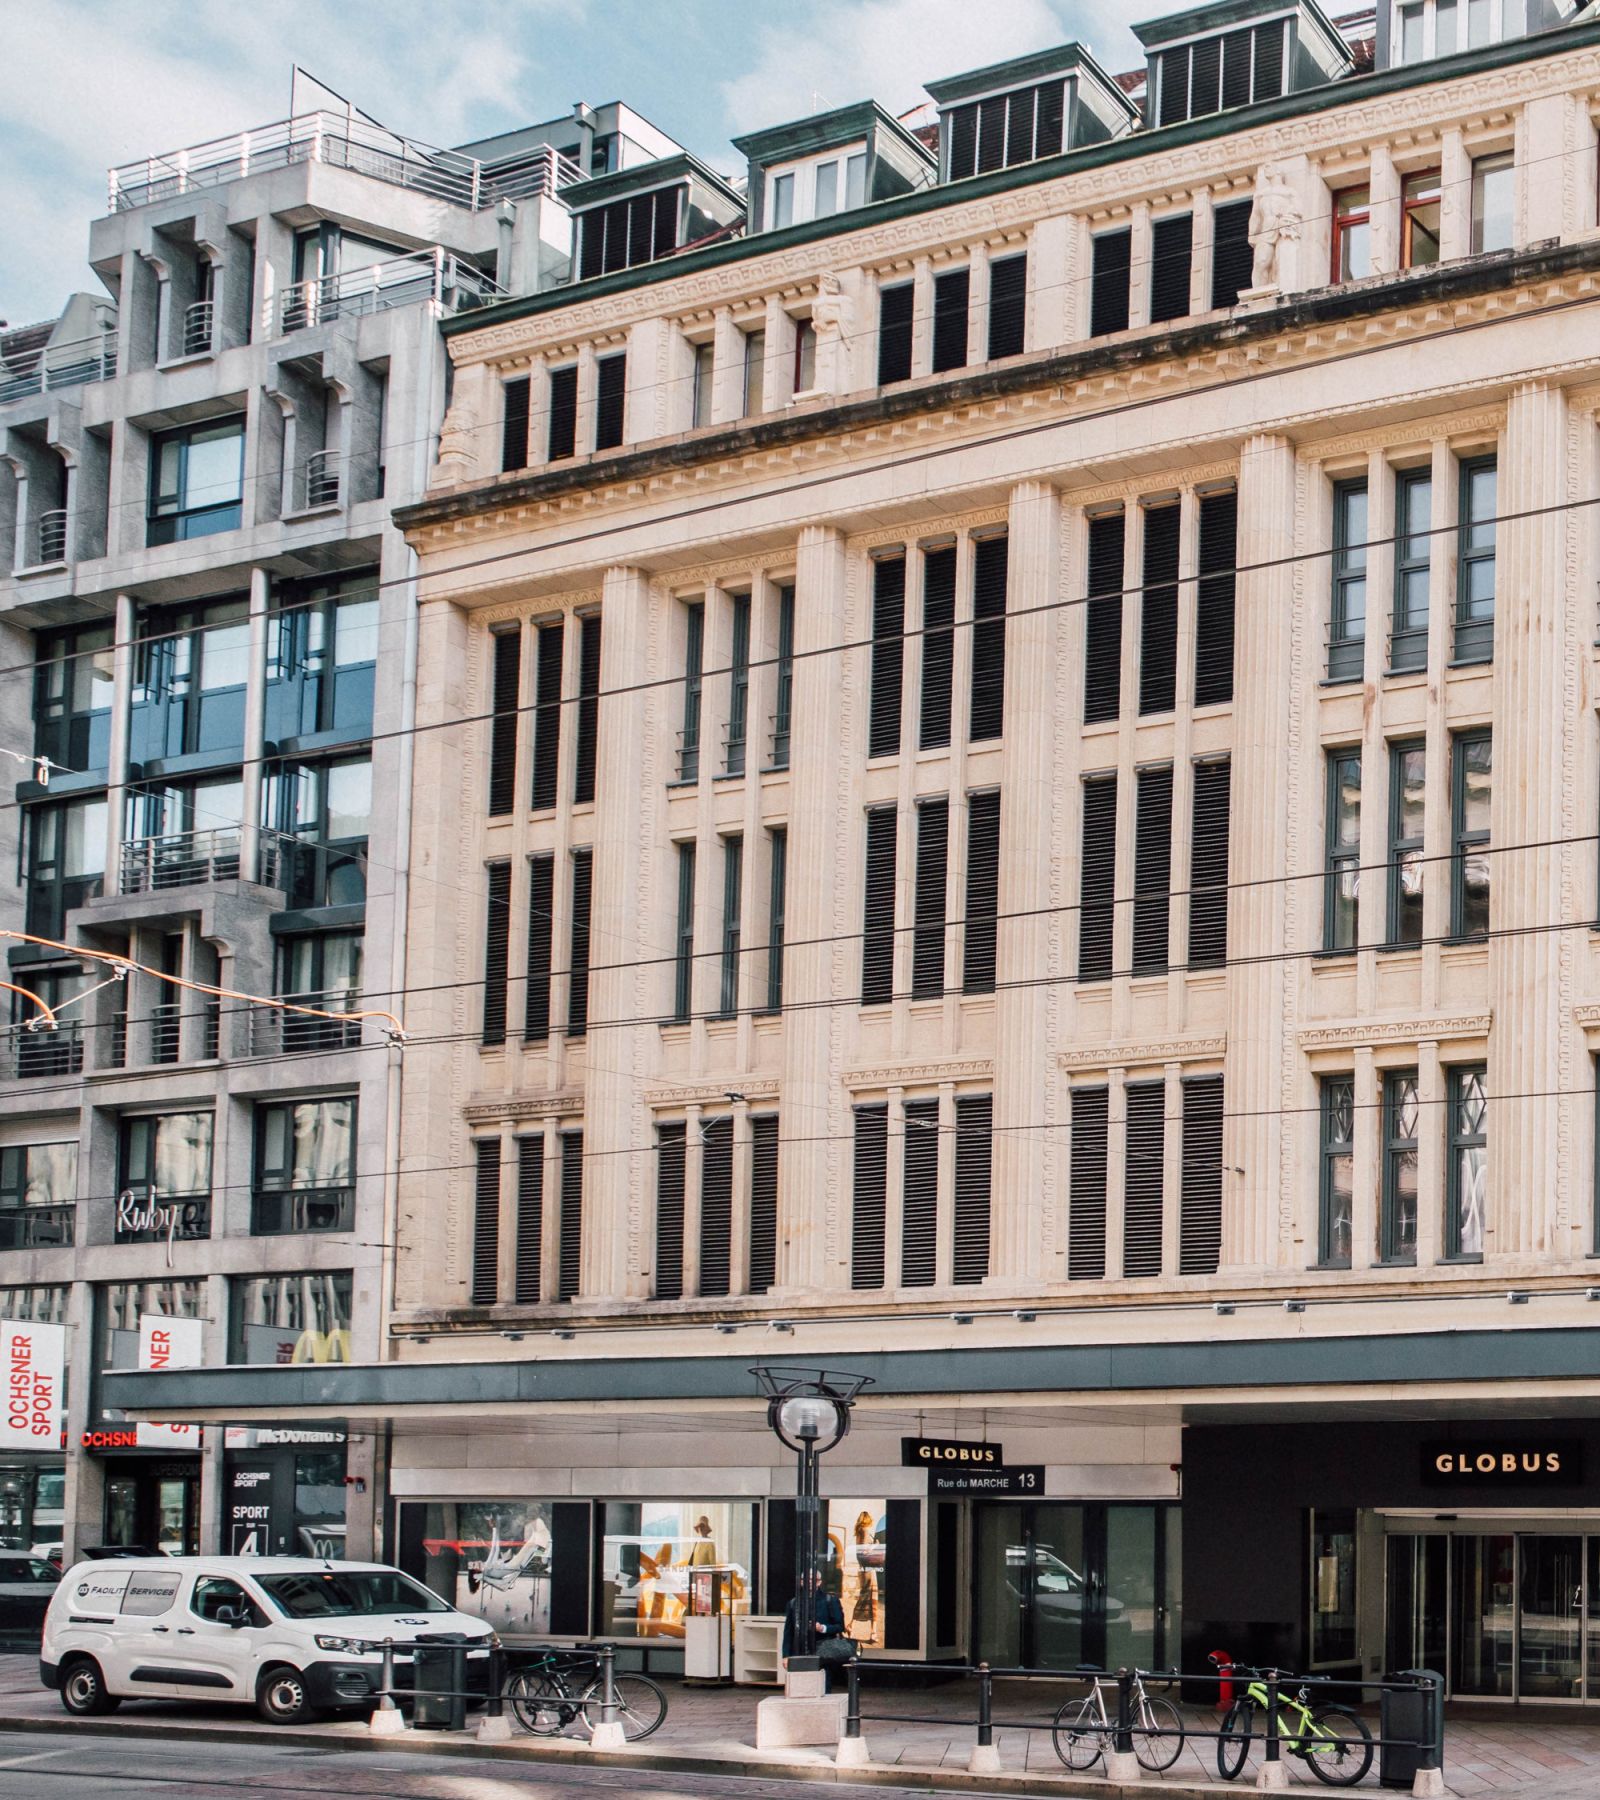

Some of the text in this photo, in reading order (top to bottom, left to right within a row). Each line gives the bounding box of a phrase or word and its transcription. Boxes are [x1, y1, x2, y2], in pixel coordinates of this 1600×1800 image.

[117, 1185, 177, 1267] Ruby
[8, 1335, 33, 1429] OCHSNER
[31, 1372, 53, 1436] SPORT
[81, 1431, 137, 1447] OCHSNE
[257, 1428, 347, 1443] McDonalds
[919, 1446, 994, 1462] GLOBUS
[1435, 1453, 1560, 1473] GLOBUS
[233, 1479, 258, 1488] SPORT
[236, 1472, 271, 1480] OCHSNER
[937, 1473, 1036, 1488] Rue du MARCHE 13
[232, 1505, 270, 1519] SPORT
[239, 1531, 260, 1556] 4
[129, 1587, 175, 1596] SERVICES
